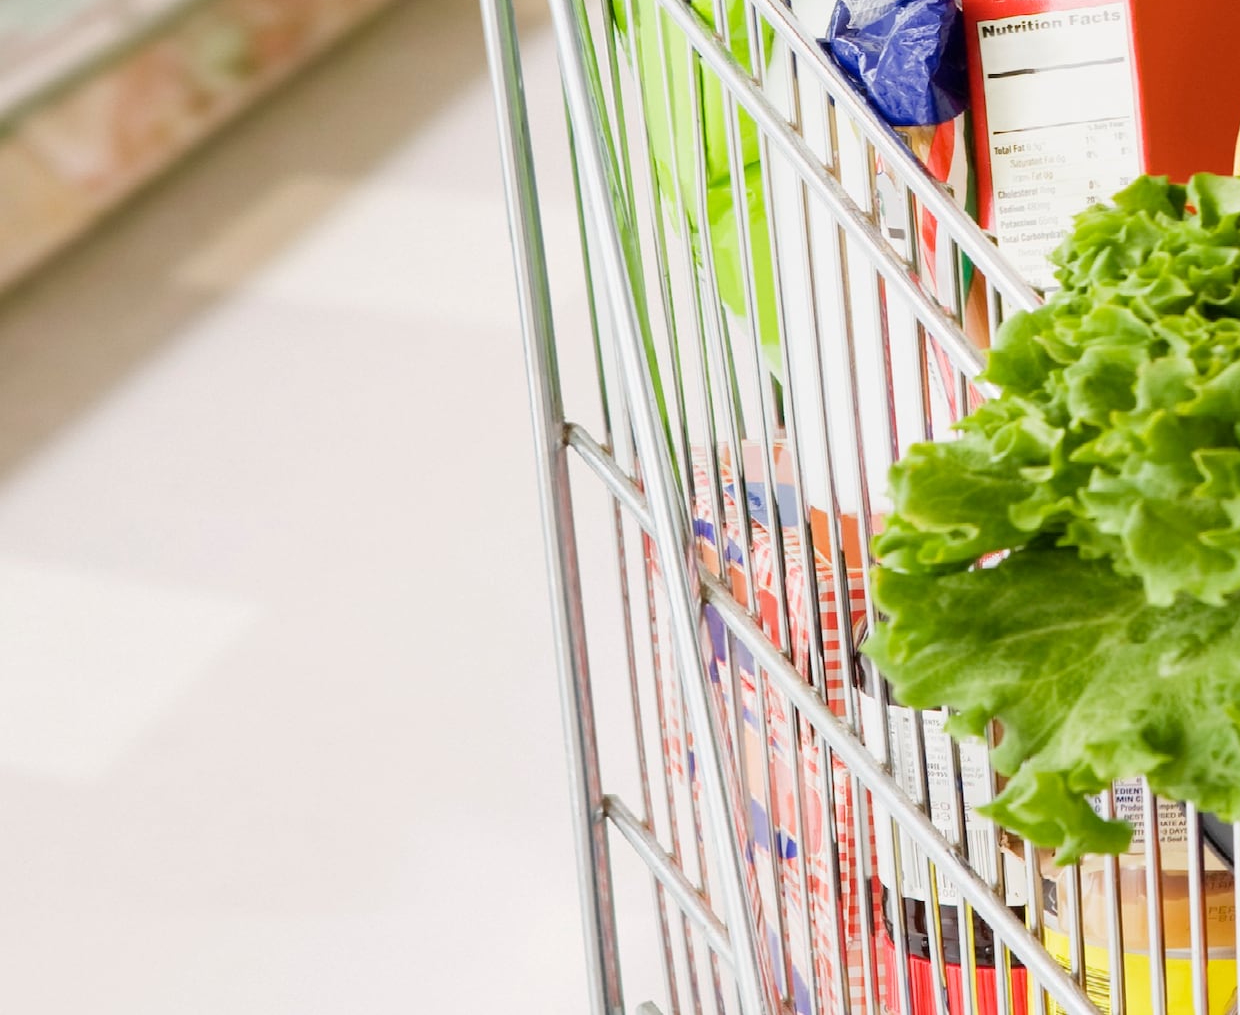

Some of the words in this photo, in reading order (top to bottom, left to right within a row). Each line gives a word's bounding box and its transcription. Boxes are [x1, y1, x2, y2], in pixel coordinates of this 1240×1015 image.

[982, 17, 1062, 38] Nutrition
[1069, 10, 1121, 26] Facts
[994, 144, 1012, 155] Total
[1013, 144, 1025, 153] Fat
[998, 187, 1038, 199] Cholesterol
[999, 204, 1025, 214] Sodium
